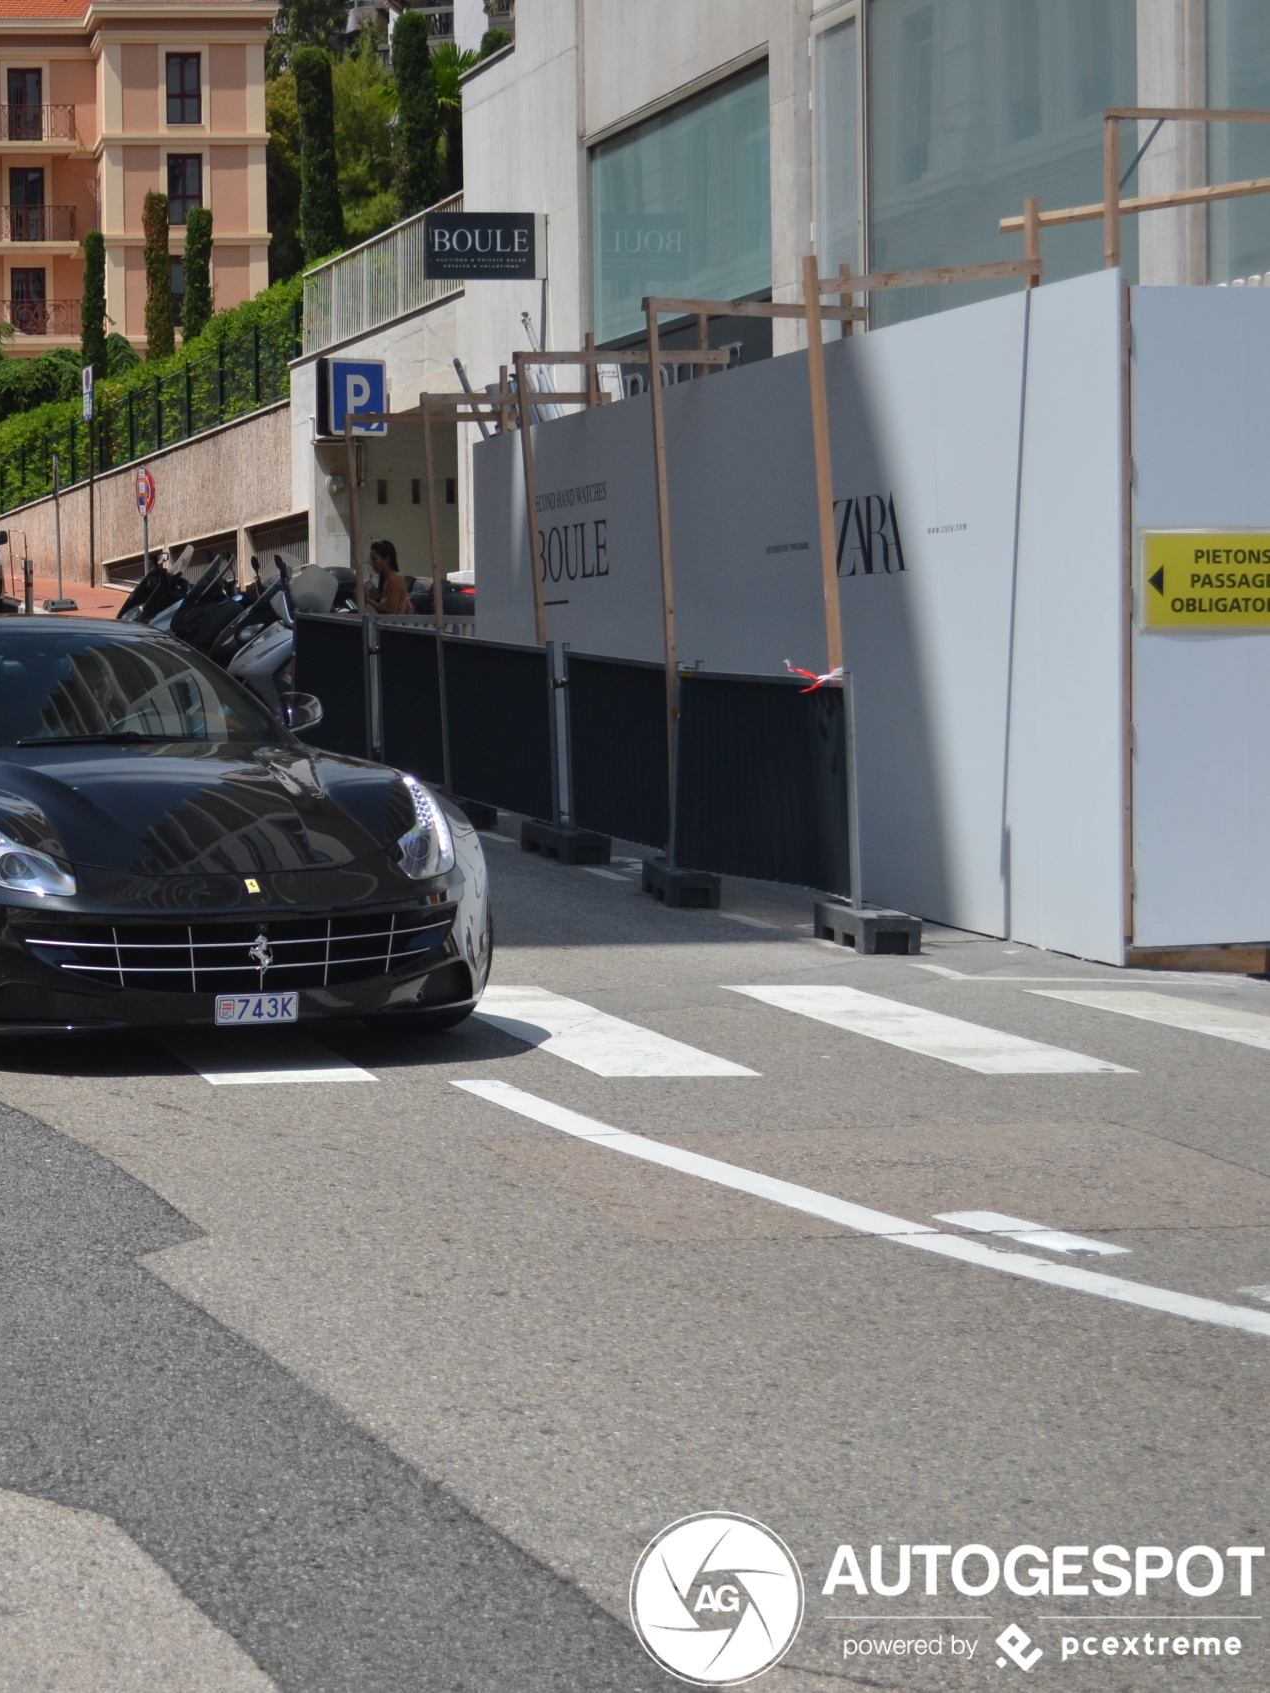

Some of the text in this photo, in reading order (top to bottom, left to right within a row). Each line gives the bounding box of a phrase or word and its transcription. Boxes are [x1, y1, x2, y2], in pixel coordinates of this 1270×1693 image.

[433, 228, 529, 253] BOULE
[346, 374, 371, 414] P
[535, 481, 607, 513] ECOND HAND WATCHES
[832, 491, 909, 577] ZARA
[927, 523, 967, 534] www.zara.com
[1194, 549, 1270, 564] PIETONS
[222, 997, 293, 1019] MC 743K
